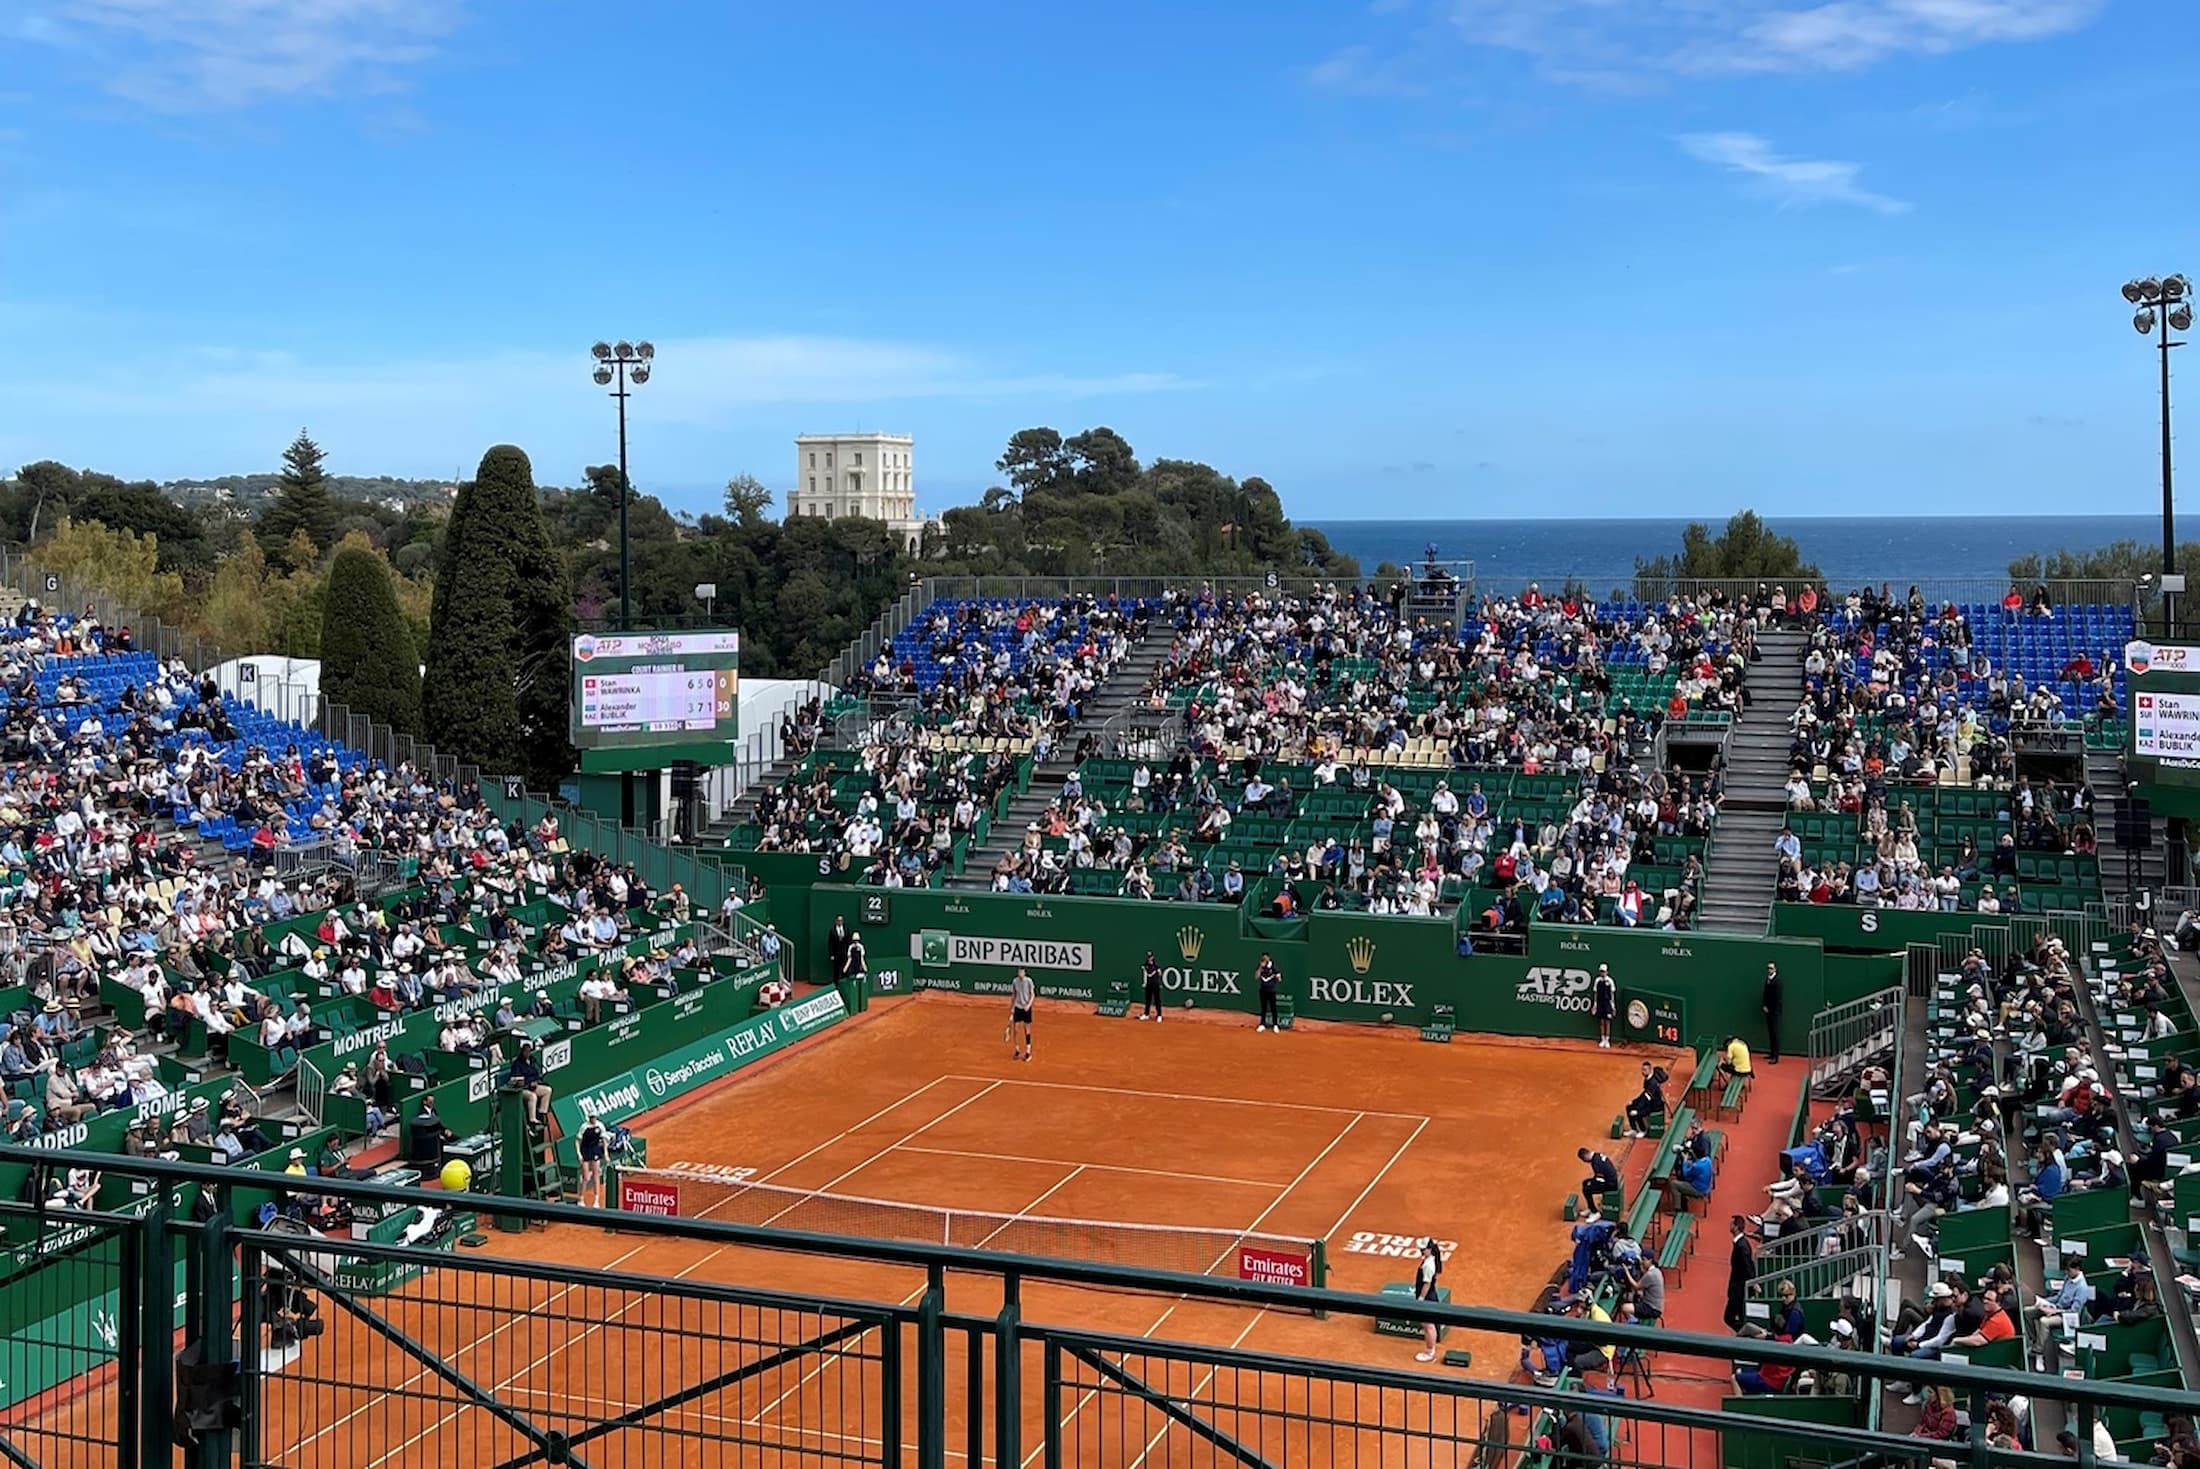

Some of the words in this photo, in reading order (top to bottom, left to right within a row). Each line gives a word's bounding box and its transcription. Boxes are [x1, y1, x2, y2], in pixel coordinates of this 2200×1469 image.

[46, 576, 58, 591] G
[1267, 573, 1278, 588] S
[2153, 648, 2187, 662] ATP
[242, 667, 253, 681] K
[600, 679, 617, 687] Stan
[687, 679, 695, 689] 6
[706, 679, 714, 689] 0
[719, 677, 728, 689] 0
[600, 701, 637, 711] Alexander
[717, 701, 730, 712] 30
[2159, 698, 2180, 709] Stan
[600, 711, 627, 720] BUBLIK
[2139, 711, 2153, 719] SUI
[2139, 740, 2154, 748] KAZ
[2159, 740, 2194, 751] BUBLIK
[508, 782, 518, 798] K
[819, 859, 831, 875] S
[867, 896, 882, 910] 22
[2135, 891, 2150, 910] J
[944, 904, 970, 914] ROLEX
[1026, 909, 1052, 919] ROLEX
[1861, 913, 1878, 932] S
[648, 929, 676, 950] TURIN
[1560, 941, 1591, 951] ROLEX
[599, 946, 628, 968] PARIS
[955, 939, 994, 961] BNP
[1000, 942, 1083, 967] PARIBAS
[1661, 947, 1692, 957] ROLEX
[523, 963, 578, 993] SHANGHAI
[878, 970, 898, 985] 191
[927, 978, 960, 989] PARIBAS
[1141, 965, 1241, 995] OLEX
[1515, 966, 1592, 997] ATP
[974, 981, 992, 991] BNP
[992, 982, 1013, 993] PARI
[1040, 985, 1057, 996] BNP
[1059, 986, 1093, 999] PARIBAS
[1309, 976, 1416, 1008] ROLEX
[433, 987, 500, 1022] CINCINNATI
[793, 1004, 811, 1021] BNP
[810, 994, 841, 1015] PARIBAS
[1515, 992, 1556, 1005] MASTERS
[1555, 995, 1592, 1012] 1000
[1099, 1006, 1124, 1017] REPLAY
[1655, 1008, 1679, 1021] ROLEX
[333, 1019, 407, 1057] MONTREAL
[725, 1020, 777, 1060] REPLAY
[1656, 1024, 1679, 1042] 1:43
[663, 1064, 694, 1086] Sergio
[688, 1048, 725, 1075] Tacchini
[138, 1090, 187, 1122] ROME
[578, 1082, 641, 1116] Malongo
[668, 1160, 759, 1177] CARLO
[625, 1187, 676, 1207] Emirates
[1243, 1254, 1304, 1278] Emirates
